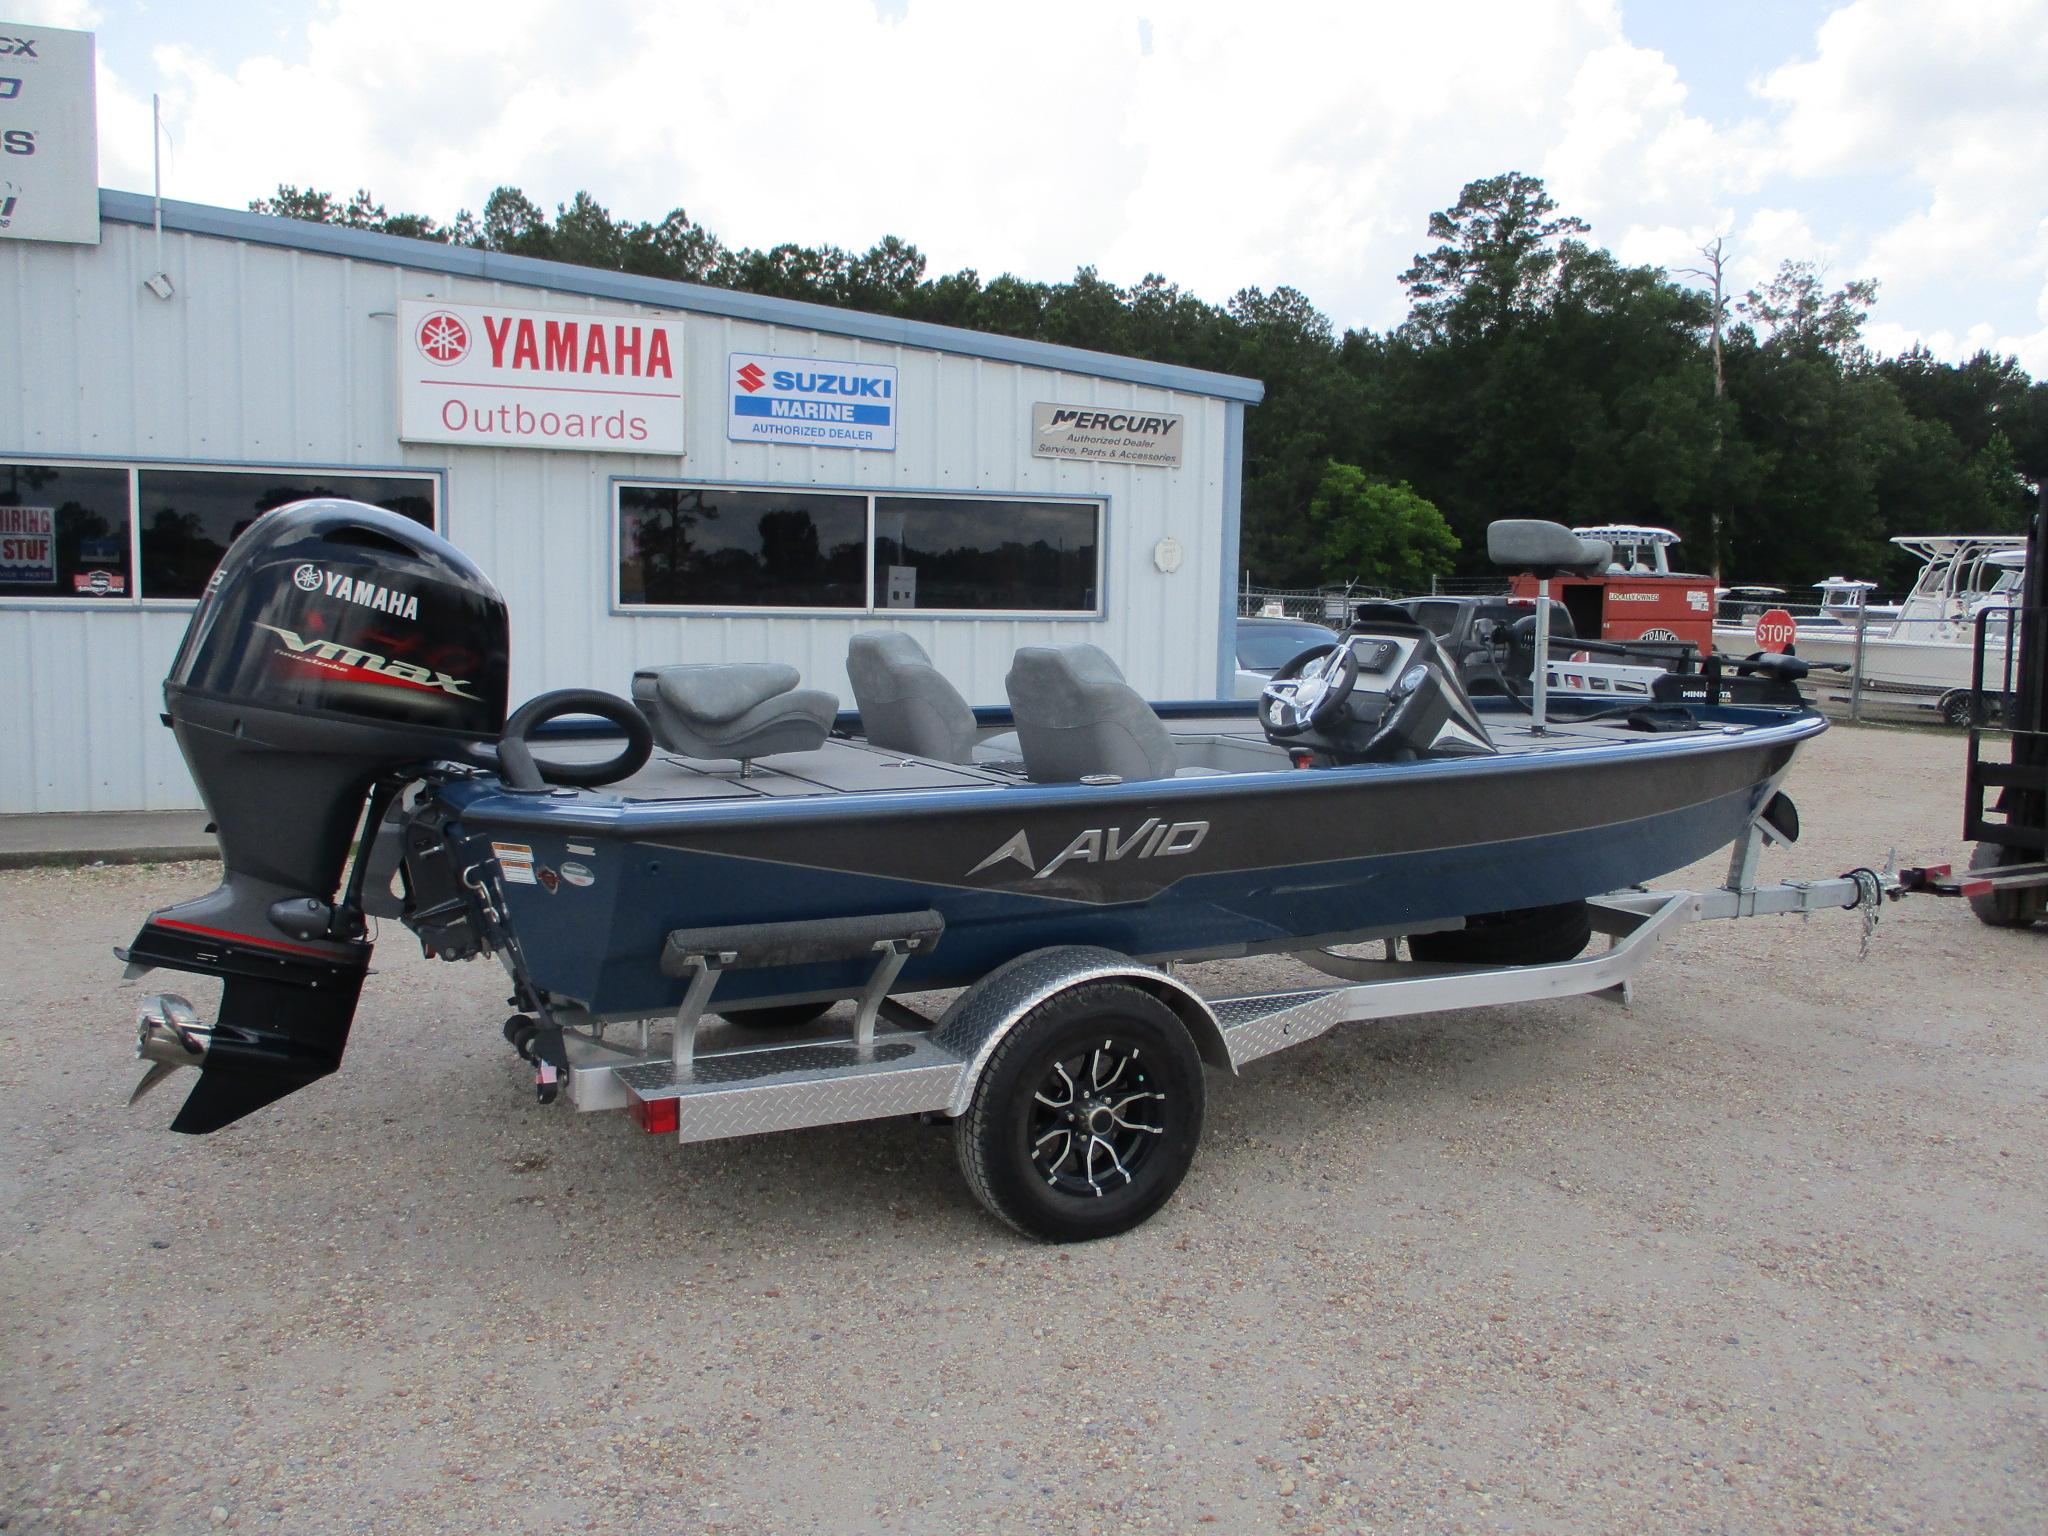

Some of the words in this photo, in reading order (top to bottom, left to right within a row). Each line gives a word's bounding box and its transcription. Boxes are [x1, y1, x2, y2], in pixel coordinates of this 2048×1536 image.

[483, 315, 673, 379] YAMAHA
[772, 370, 892, 398] SUZUKI
[441, 399, 648, 441] Outboards
[770, 400, 855, 422] MARINE
[1050, 409, 1177, 436] MERCURY
[752, 423, 827, 438] AUTHORIZED
[829, 428, 873, 441] DEALER
[1066, 433, 1122, 446] Authorized
[1122, 437, 1155, 449] Dealer
[1038, 443, 1077, 456] Service,
[1080, 447, 1106, 457] Parts
[1109, 449, 1117, 458] &
[1119, 451, 1177, 463] Accessories
[324, 571, 419, 621] YAMAHA
[1757, 624, 1794, 643] STOP
[1682, 690, 1707, 698] MINN
[1033, 817, 1210, 879] AVID
